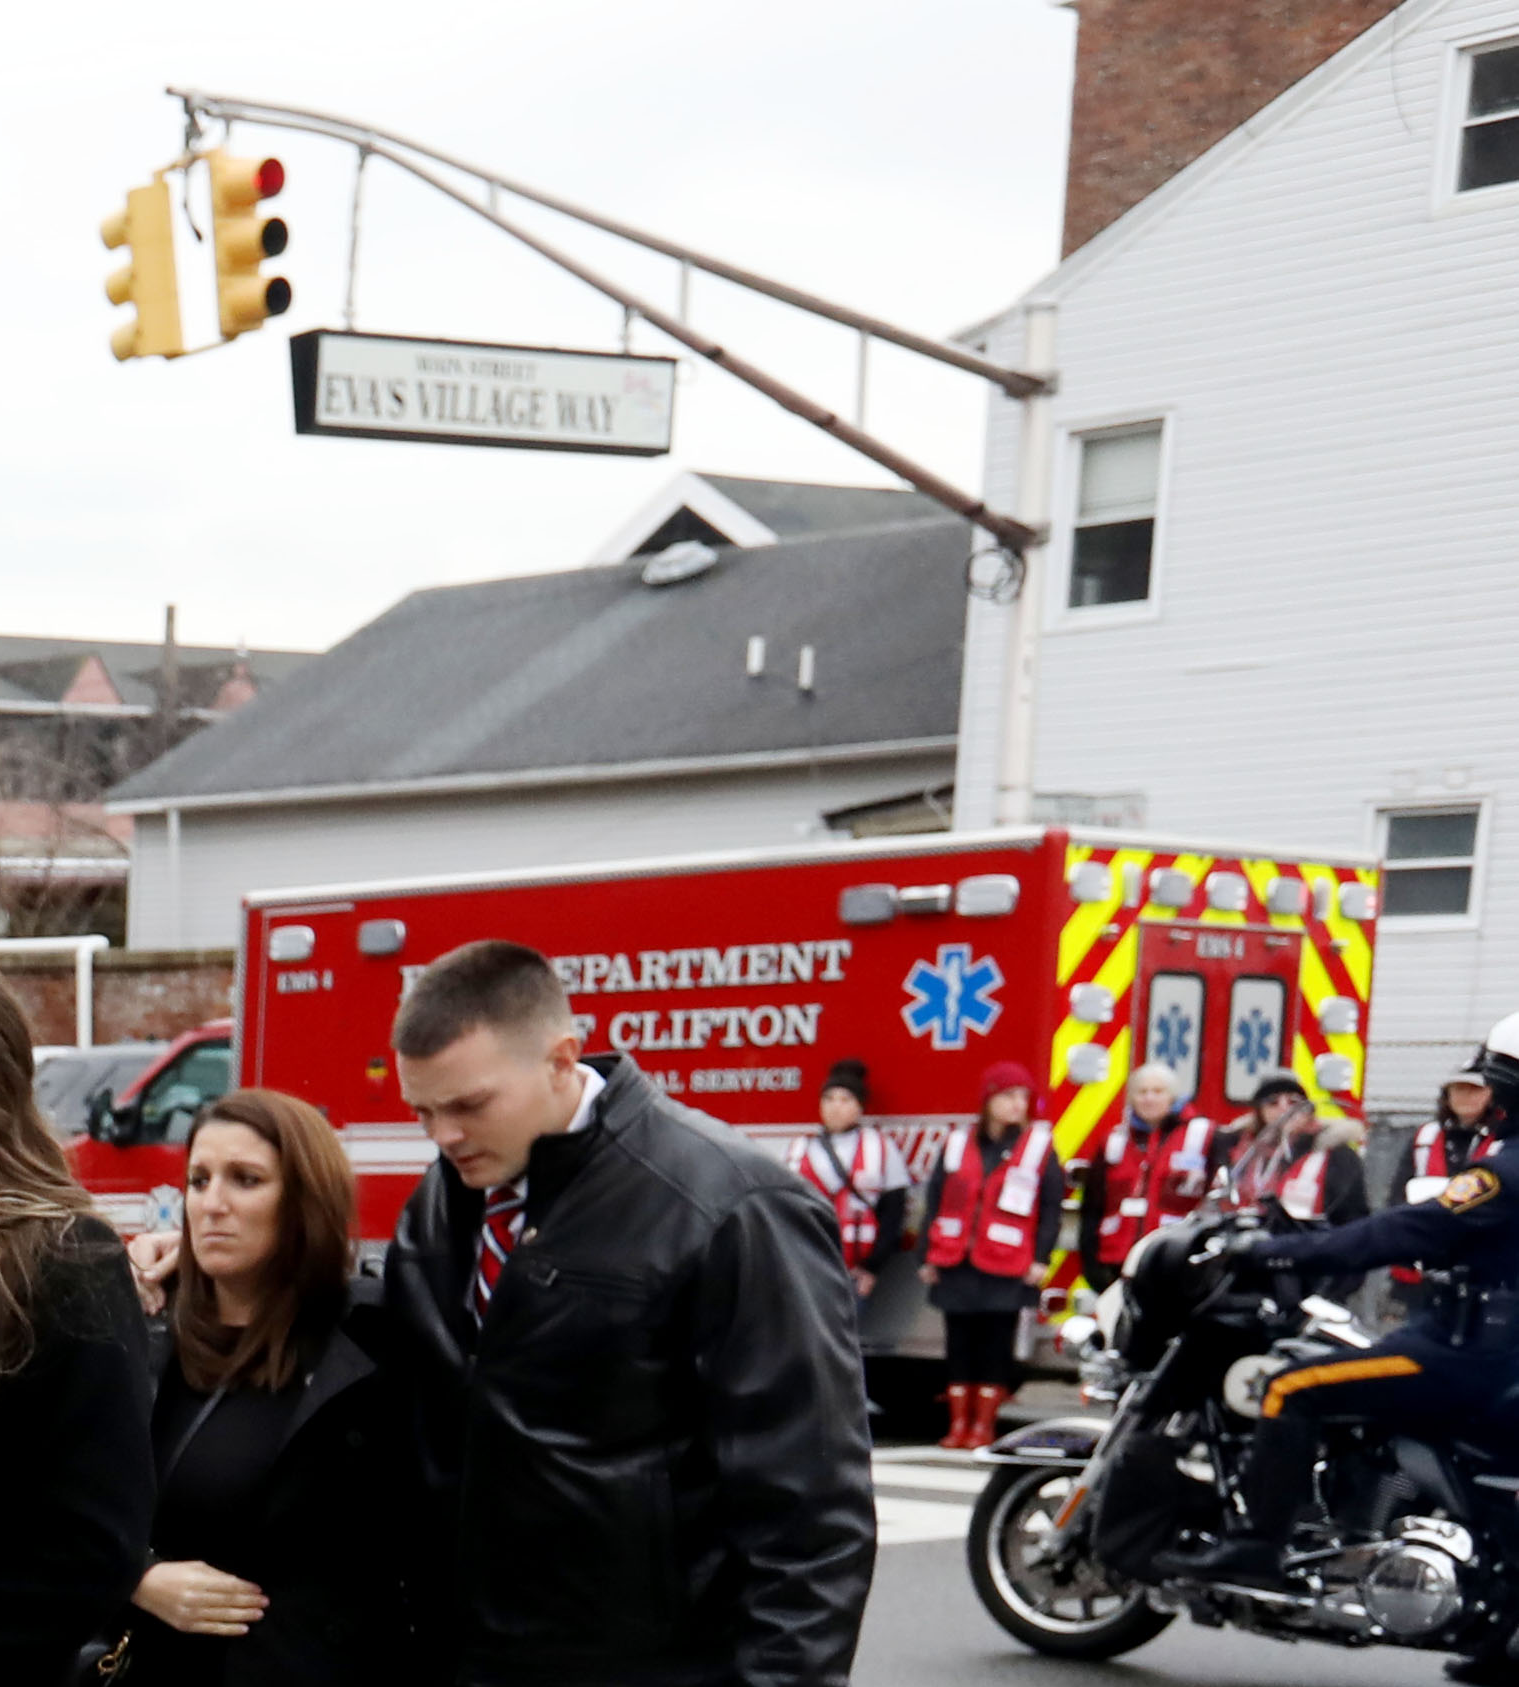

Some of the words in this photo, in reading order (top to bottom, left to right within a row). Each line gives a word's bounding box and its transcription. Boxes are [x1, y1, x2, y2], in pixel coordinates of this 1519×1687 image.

[322, 371, 407, 419] EVA'S
[418, 380, 547, 430] VILLAGE
[556, 389, 620, 435] WAY
[553, 939, 851, 996] EPARTMENT
[608, 1004, 822, 1051] CLIFTON
[689, 1066, 802, 1093] SERVICE
